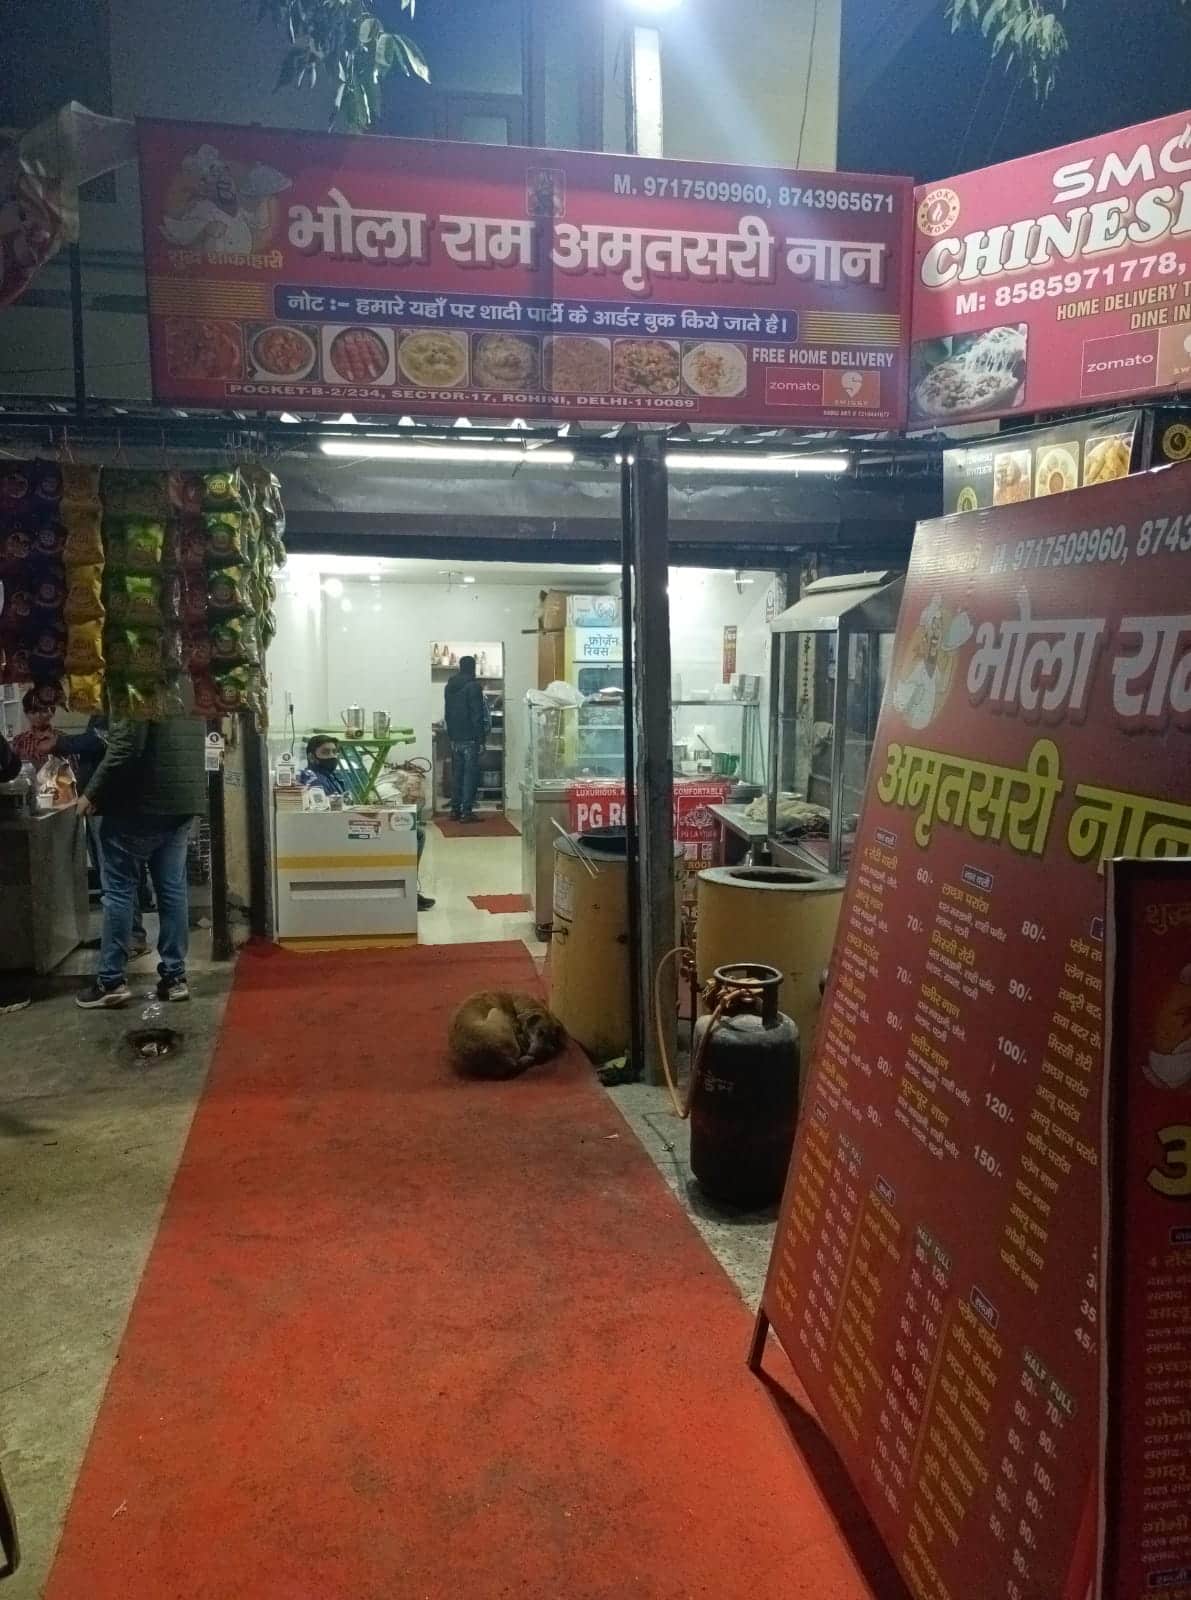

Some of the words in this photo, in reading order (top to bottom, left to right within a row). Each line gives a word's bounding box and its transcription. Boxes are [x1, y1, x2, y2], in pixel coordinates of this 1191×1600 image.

[614, 174, 637, 196] M.
[644, 177, 772, 208] 9717509960,
[778, 189, 893, 213] 8743965671
[288, 187, 426, 258] भोला
[439, 213, 535, 264] राम
[552, 216, 775, 291] अमृतसरी
[786, 236, 886, 285] नान
[956, 293, 986, 315] M:
[995, 251, 1186, 307] 8585971778,
[287, 294, 324, 312] नोट
[356, 295, 403, 317] हमारे
[409, 296, 447, 319] यहाँ
[450, 304, 476, 320] पर
[480, 303, 521, 321] शादी
[526, 304, 563, 324] पार्टी
[568, 305, 588, 324] के
[593, 308, 640, 329] आर्डर
[643, 312, 675, 332] बुक
[681, 311, 718, 330] किये
[723, 312, 761, 332] जाते
[1057, 298, 1100, 320] HOME
[1104, 282, 1178, 312] DELIVERY
[1131, 308, 1169, 330] DINE
[1173, 303, 1191, 322] IN
[752, 348, 785, 363] FREE
[790, 350, 828, 366] HOME
[831, 352, 894, 368] DELIVERY
[1087, 353, 1154, 374] zomato
[230, 384, 386, 399] POCKET-B-2/234,
[391, 388, 498, 403] SECTOR-17,
[576, 396, 695, 409] DELHI-110089
[769, 381, 820, 392] zomato
[1013, 524, 1129, 570] 9717509960,
[967, 587, 1106, 711] भोला
[877, 739, 1064, 855] अमृतसरी
[577, 803, 603, 832] PG
[1021, 920, 1045, 941] 80/-
[1008, 978, 1032, 1001] 90/-
[998, 1035, 1027, 1064] 100/-
[985, 1092, 1014, 1122] 120/-
[974, 1144, 1002, 1177] 150/-
[1050, 1380, 1071, 1413] FULL
